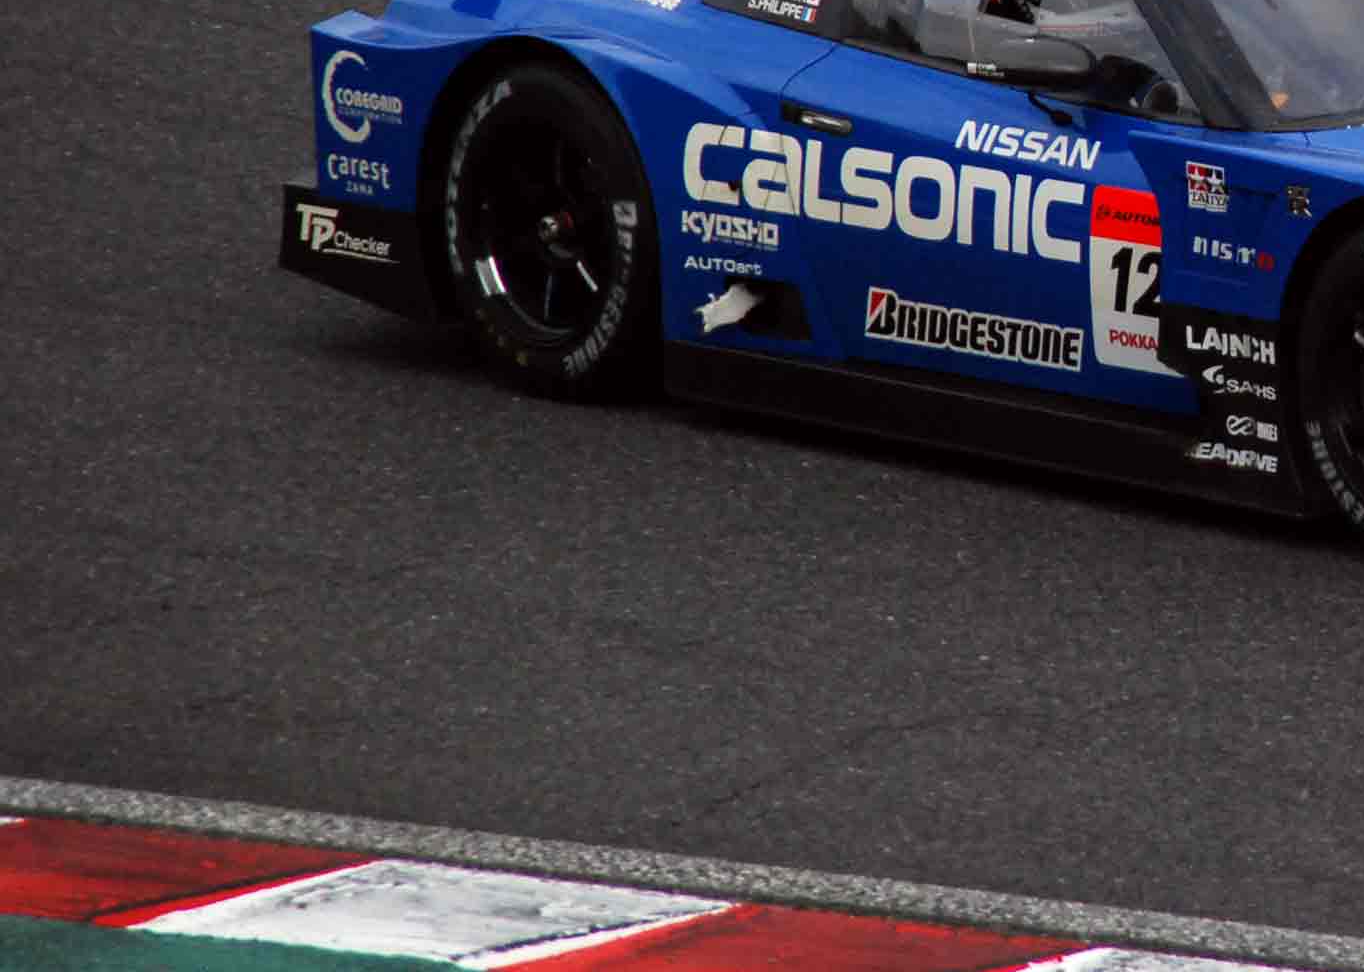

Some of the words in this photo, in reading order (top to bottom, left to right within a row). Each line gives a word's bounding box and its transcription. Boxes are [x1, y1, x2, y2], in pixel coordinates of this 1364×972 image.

[955, 119, 1101, 171] NISSAN
[683, 122, 1086, 264] CALSONIC
[335, 230, 392, 257] Checker
[681, 210, 779, 245] KYOSHO
[1111, 247, 1163, 318] 12
[867, 286, 1083, 372] BRIDGESTONE
